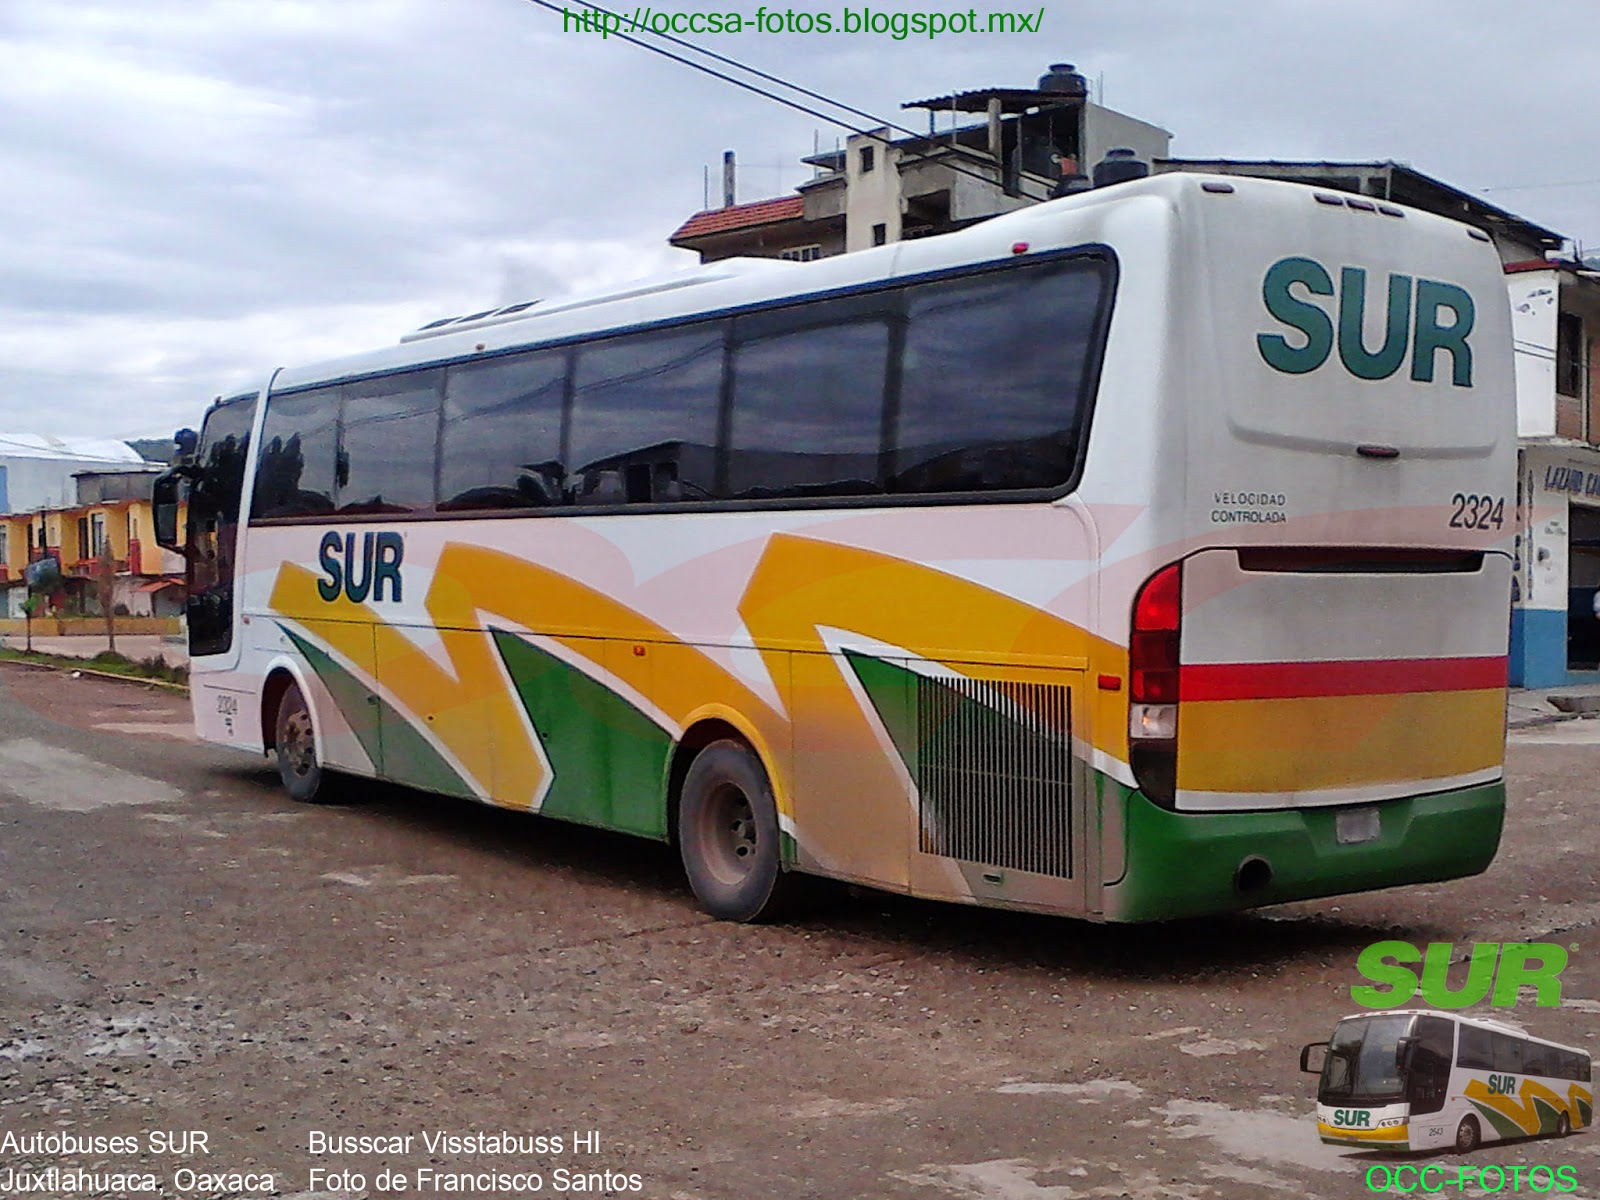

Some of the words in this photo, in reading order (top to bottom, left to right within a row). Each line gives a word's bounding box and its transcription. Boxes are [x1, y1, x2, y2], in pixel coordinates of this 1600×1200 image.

[1257, 257, 1476, 388] SUR
[1211, 509, 1287, 523] CONTROLADA
[1214, 492, 1286, 506] VELOCIDAD
[1449, 493, 1504, 530] 2324
[317, 531, 404, 603] SUR
